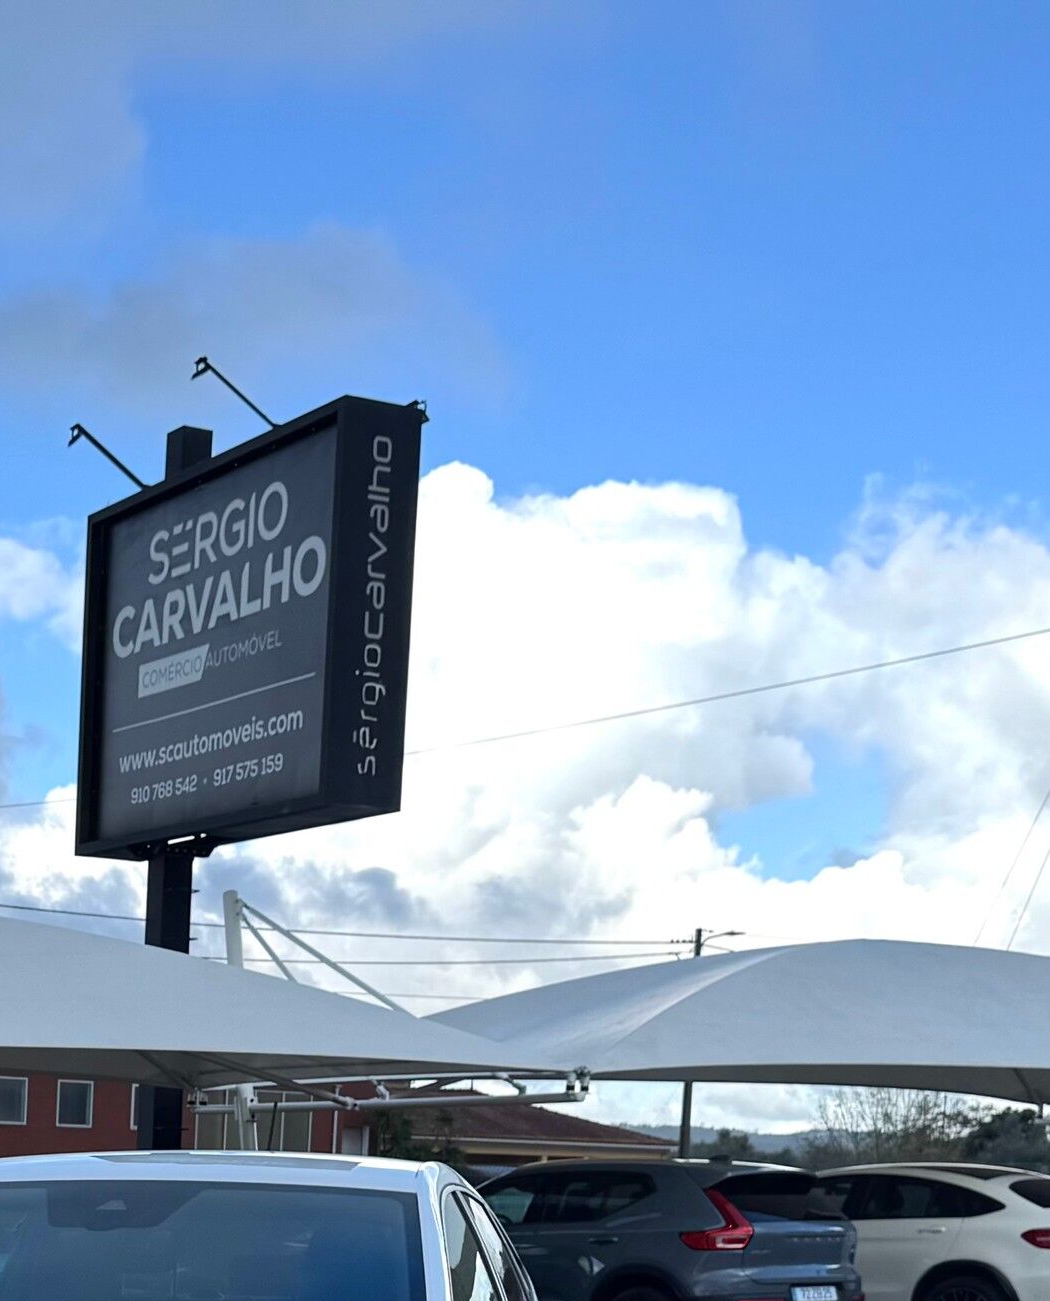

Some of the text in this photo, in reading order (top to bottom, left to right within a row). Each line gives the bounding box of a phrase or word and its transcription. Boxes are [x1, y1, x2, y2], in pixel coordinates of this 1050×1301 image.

[113, 535, 326, 658] CARVALHO
[141, 630, 282, 689] COMÉRCIO AUTOMÓVEL
[118, 709, 304, 774] www.scautomoveis.com
[130, 752, 284, 804] 910 768 542 917 575 159
